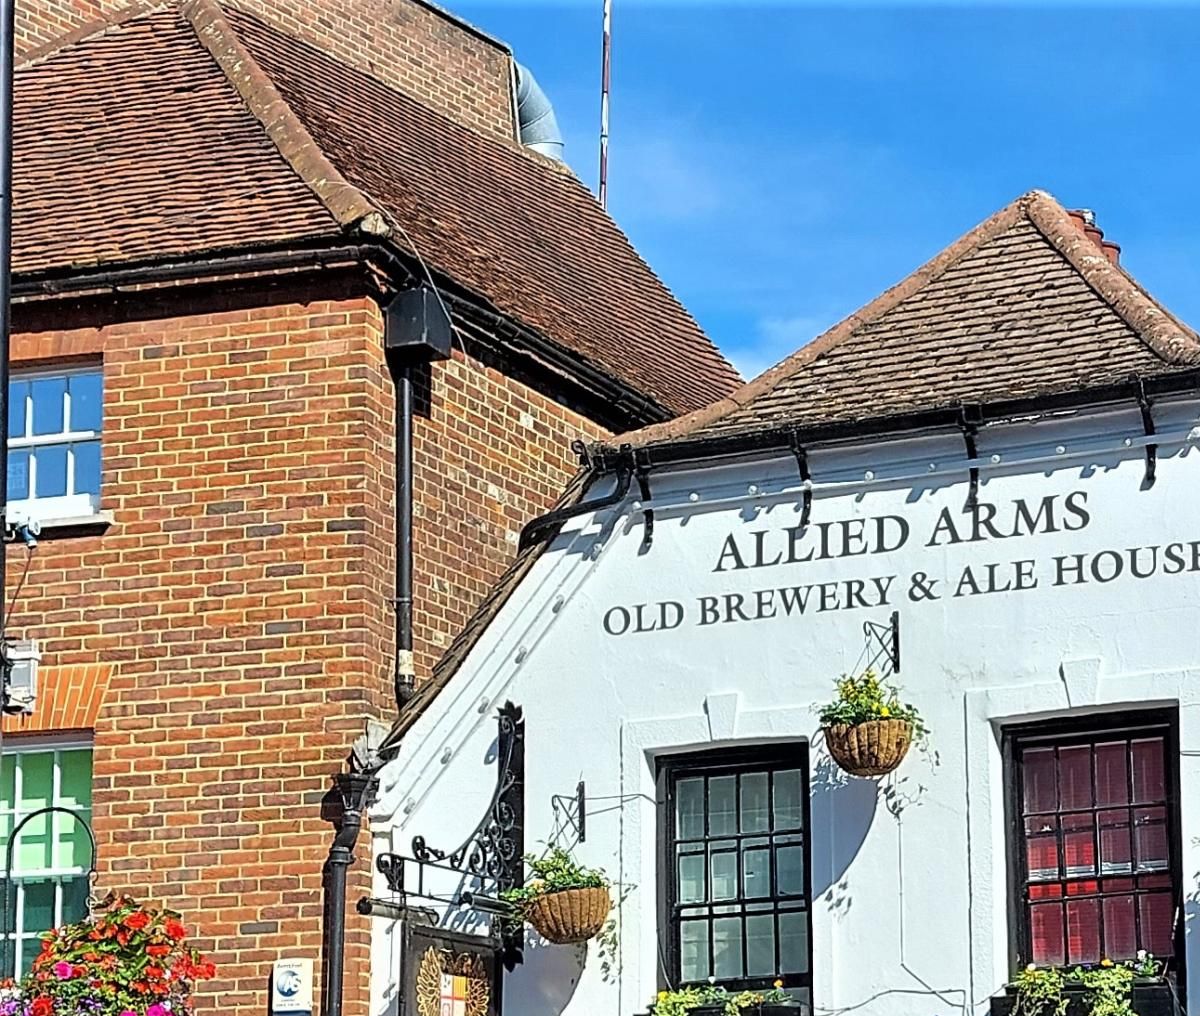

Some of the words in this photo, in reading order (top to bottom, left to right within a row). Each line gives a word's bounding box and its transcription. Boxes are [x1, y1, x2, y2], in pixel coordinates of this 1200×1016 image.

[712, 513, 909, 573] ALLIED
[925, 490, 1092, 547] ARMS
[603, 600, 685, 636] OLD
[696, 575, 897, 627] BREWERY
[907, 571, 940, 602] &
[953, 560, 1038, 598] ALE
